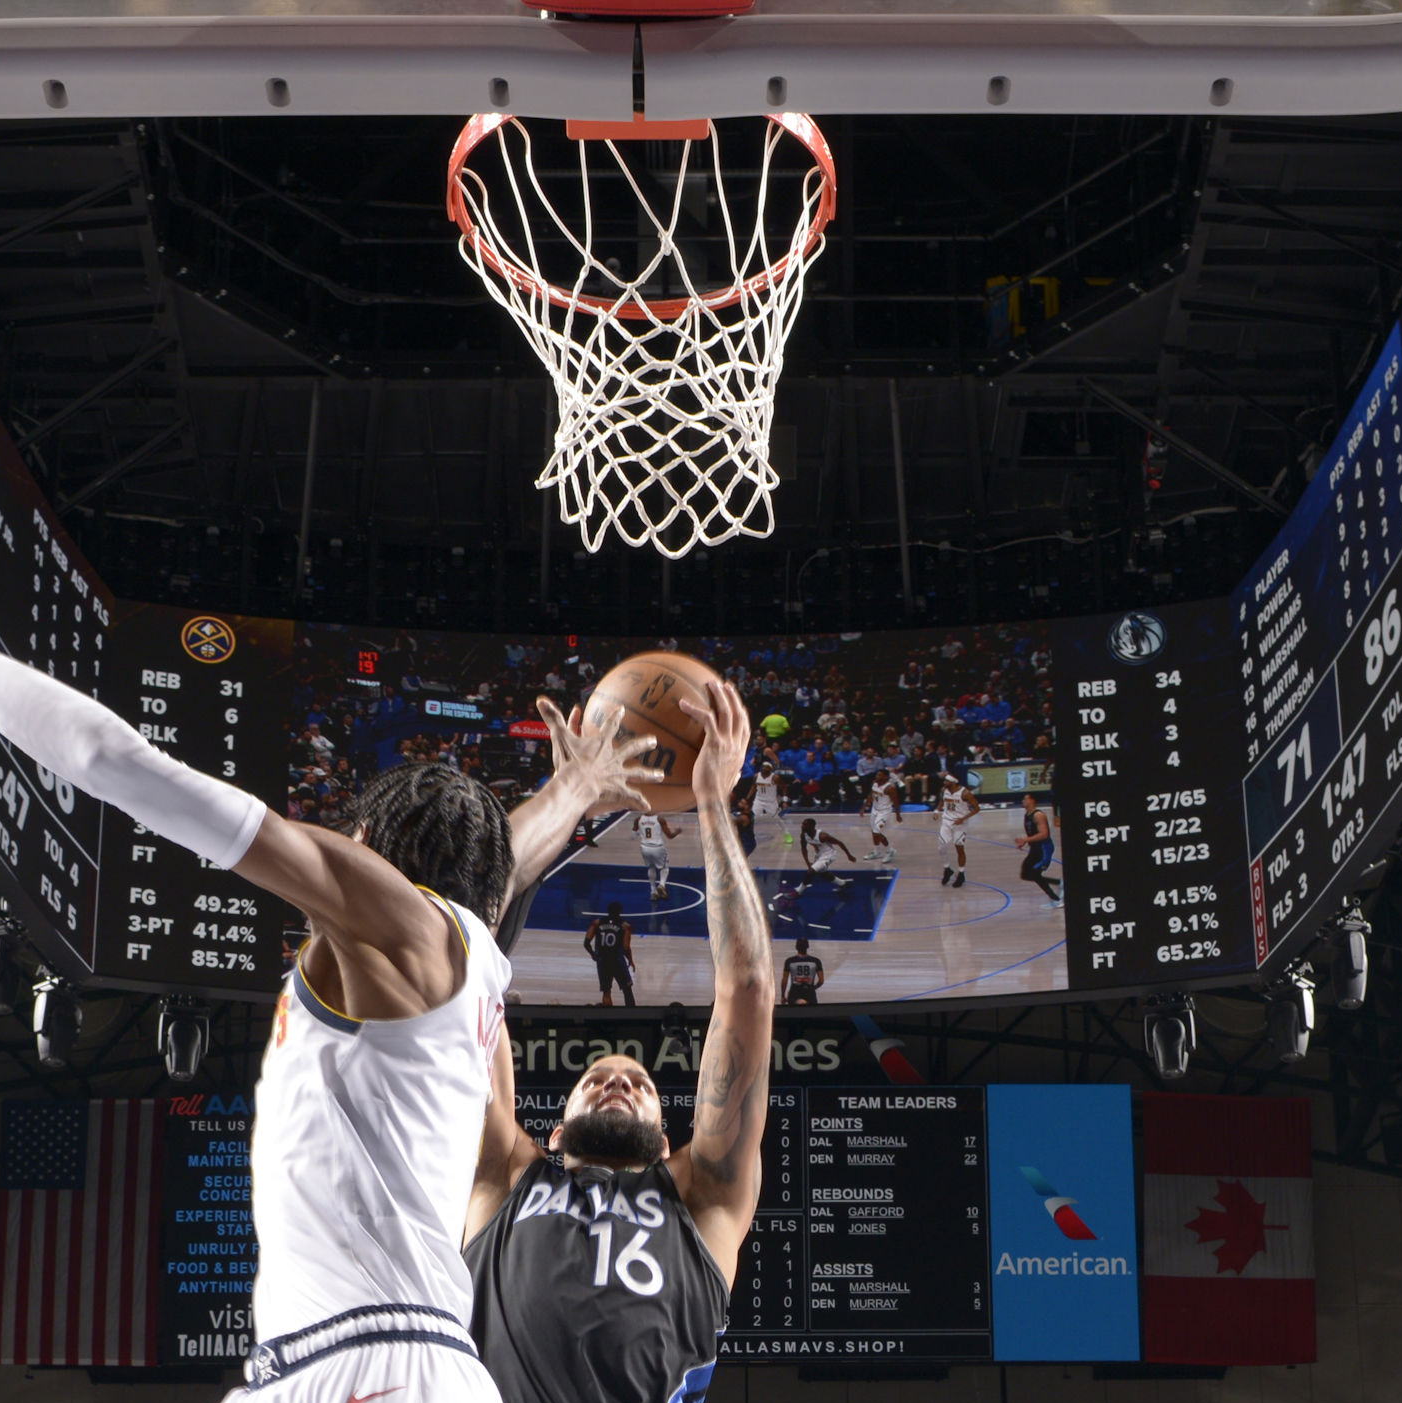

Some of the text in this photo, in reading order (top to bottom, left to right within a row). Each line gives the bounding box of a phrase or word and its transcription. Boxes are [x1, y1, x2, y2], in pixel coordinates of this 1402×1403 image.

[1255, 549, 1289, 602] PLAYER
[1257, 577, 1293, 631] POWELL
[1259, 592, 1302, 657] WILLIAMS
[1363, 588, 1401, 685] 86
[1243, 617, 1308, 706] 13 MARSHALL
[141, 669, 243, 697] REB 31
[1077, 670, 1182, 698] REB 34
[1263, 660, 1298, 714] MARTIN
[140, 696, 239, 724] TO 6
[1079, 698, 1177, 724] TO 4
[1265, 667, 1315, 741] THOMPSON
[1382, 690, 1402, 732] TOL
[139, 723, 178, 743] BLK
[1080, 724, 1178, 751] BLK 3
[222, 761, 236, 777] 3
[1082, 751, 1180, 777] STL 4
[1277, 721, 1313, 807] 71
[1321, 731, 1367, 829] 1:47
[1084, 788, 1207, 818] FG 27/65
[1085, 817, 1202, 845] 3-PT 2/22
[44, 829, 65, 871] TOL
[132, 845, 157, 863] FT
[1087, 843, 1210, 872] FT 15/23
[1267, 848, 1290, 885] TOL
[41, 874, 61, 913] FLS
[129, 887, 257, 916] FG 49.2%
[1089, 885, 1217, 914] FG 41.5%
[1253, 868, 1265, 956] BONUS
[1271, 890, 1294, 929] FLS
[128, 915, 257, 944] 3-PT 41.4%
[1091, 912, 1219, 942] 3-PT 9.1%
[127, 942, 256, 972] FT 85.7%
[1092, 940, 1221, 969] FT 65.2%
[511, 1029, 644, 1072] erican
[169, 1094, 204, 1116] Tell
[769, 1095, 795, 1107] FLS
[839, 1097, 957, 1109] TEAM LEADERS
[190, 1121, 245, 1131] TELL US
[811, 1117, 863, 1130] POINTS
[809, 1136, 976, 1147] DAL MARSHALL 17
[809, 1154, 895, 1164] DEN MURRAY
[812, 1188, 894, 1200] REBOUNDS
[771, 1220, 797, 1232] FLS
[810, 1207, 904, 1217] DAL GAFFORD
[810, 1223, 886, 1233] DEN JONES
[188, 1243, 244, 1255] UNRULY
[589, 1220, 664, 1296] 16
[995, 1251, 1129, 1275] American
[168, 1263, 208, 1274] FOOD
[813, 1264, 873, 1276] ASSISTS
[179, 1281, 253, 1293] ANYTHING
[811, 1283, 910, 1293] DAL MARSHALL
[209, 1304, 252, 1329] visi
[812, 1300, 898, 1309] DEN MURRAY
[720, 1341, 904, 1353] ALLASMAVS.SHOP!
